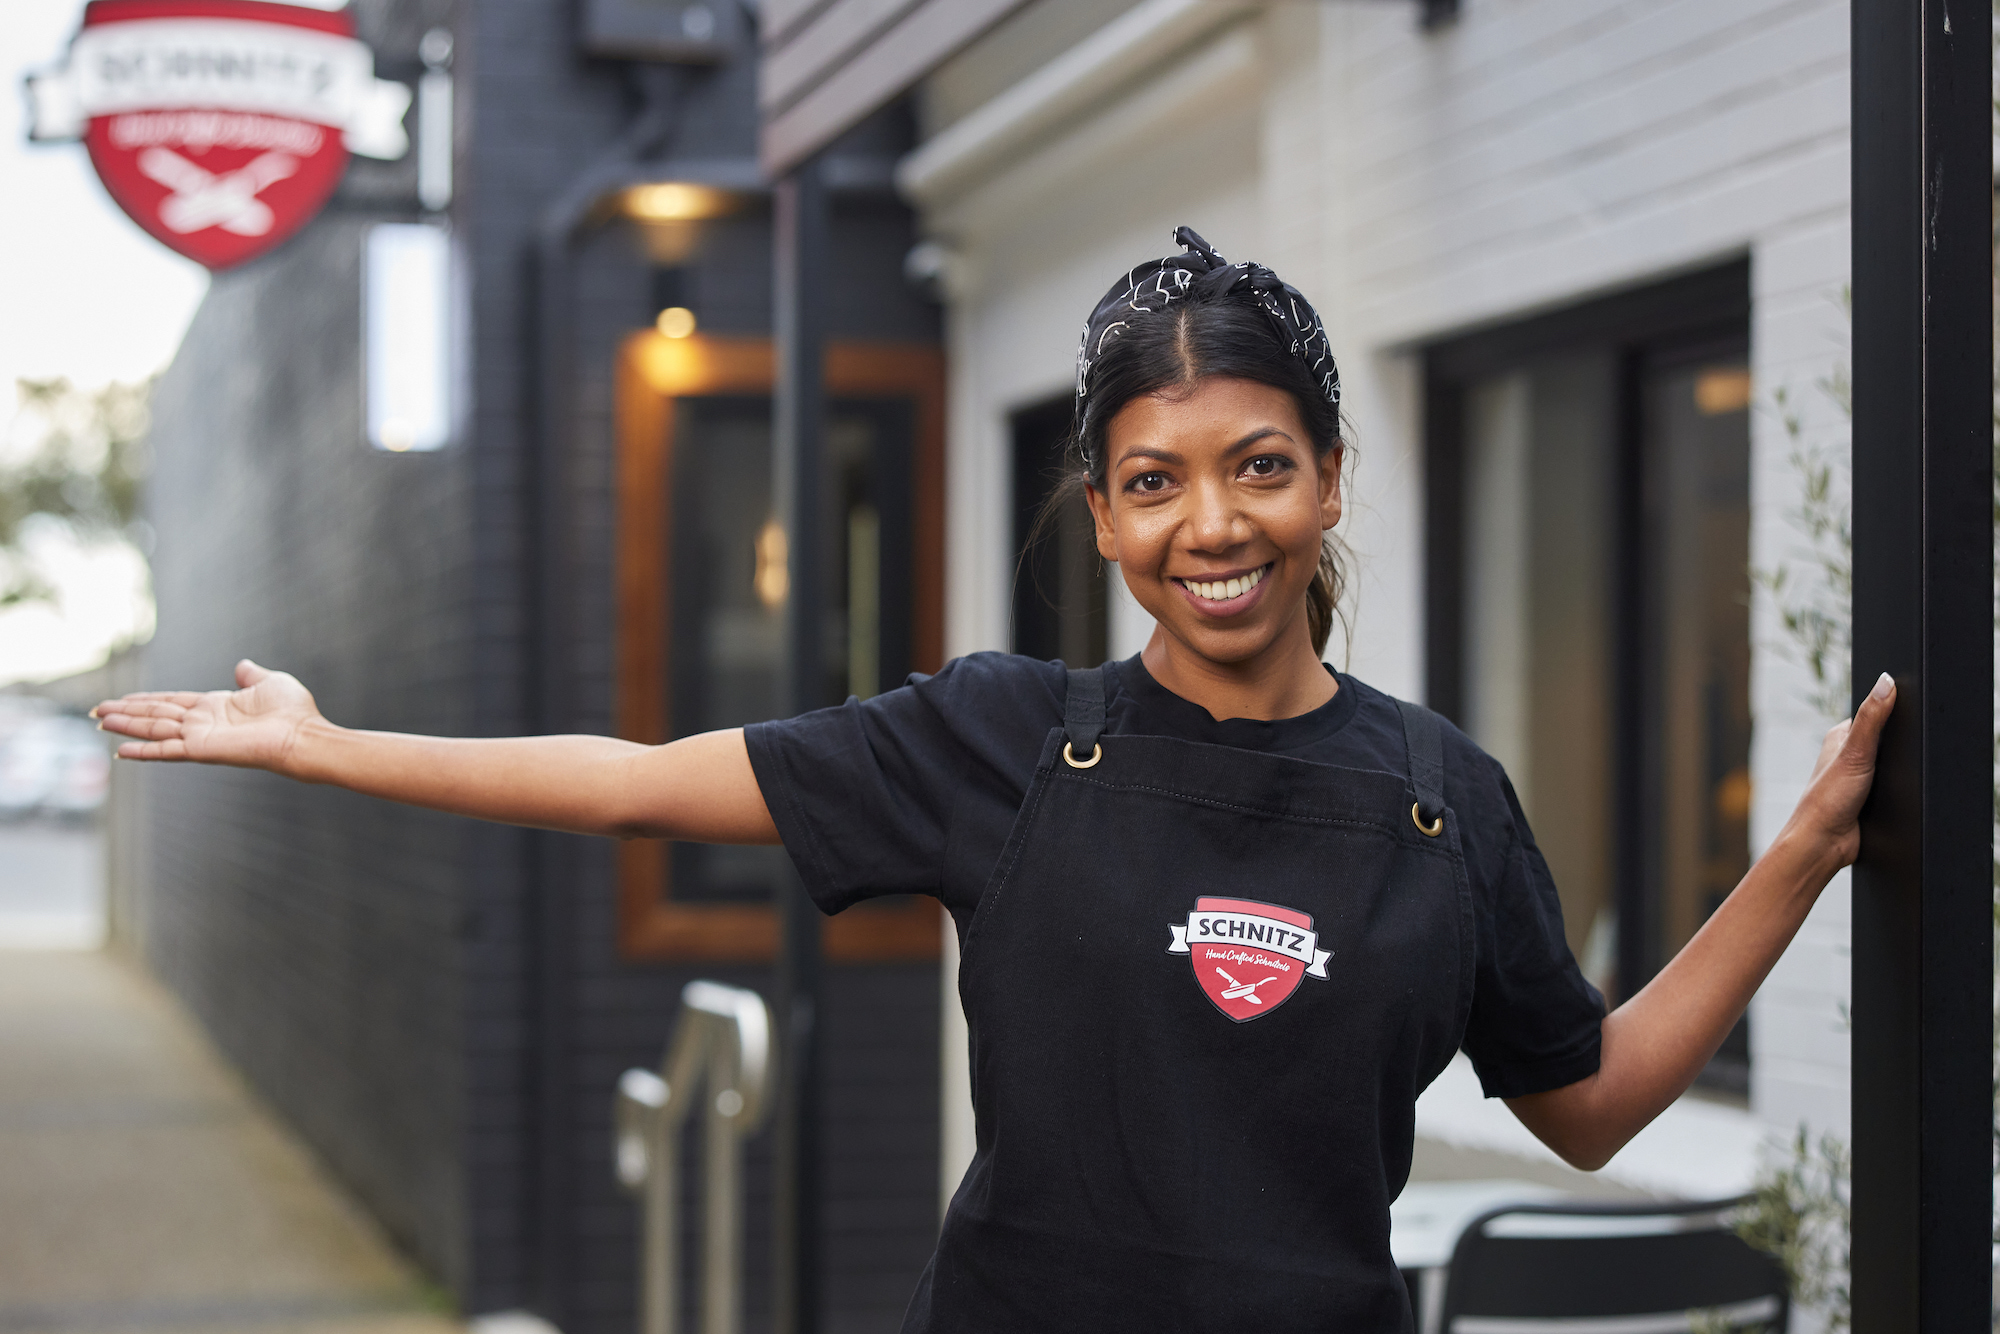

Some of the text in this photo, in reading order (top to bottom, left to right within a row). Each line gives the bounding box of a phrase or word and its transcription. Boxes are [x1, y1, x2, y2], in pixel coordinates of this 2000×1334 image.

[1199, 918, 1305, 952] SCHNITZ
[1205, 949, 1291, 972] Hand Crafted Schnitzels
